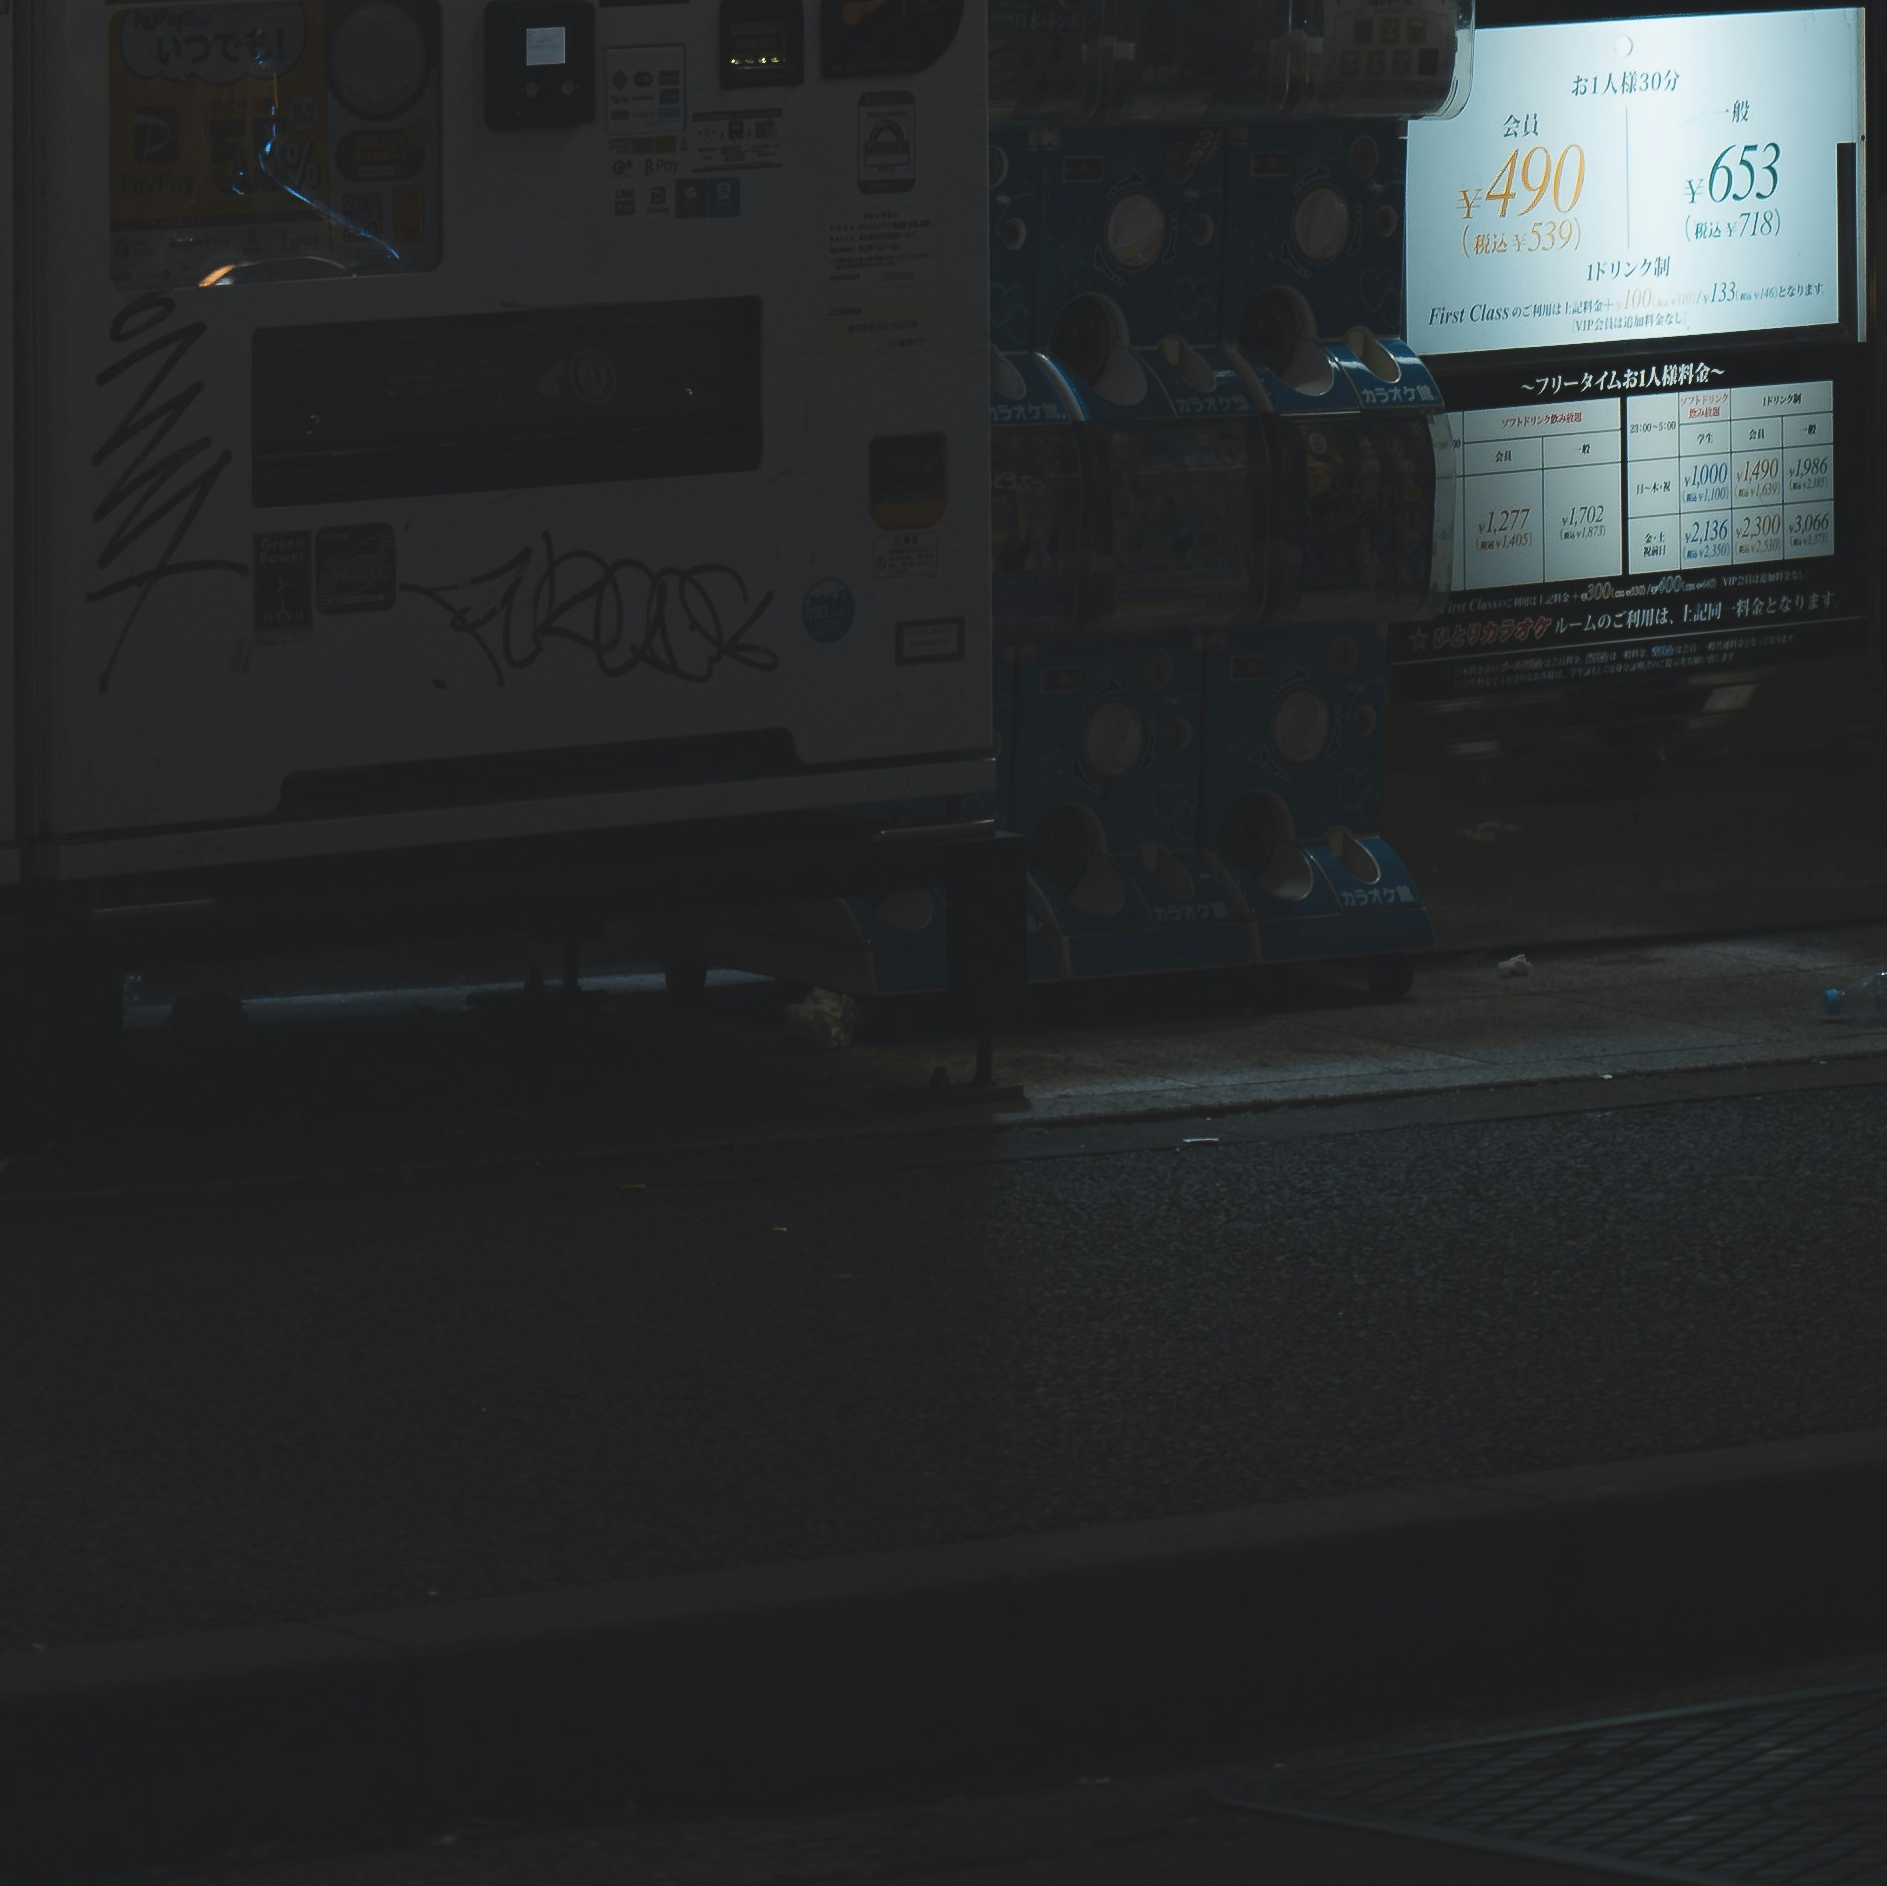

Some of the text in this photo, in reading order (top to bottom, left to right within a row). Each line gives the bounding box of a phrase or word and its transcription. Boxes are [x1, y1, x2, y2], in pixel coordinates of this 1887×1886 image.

[1570, 70, 1680, 97] お1人様30分
[1503, 114, 1539, 139] 会員
[121, 172, 195, 199] PayPay
[1457, 143, 1586, 220] ¥490
[1684, 142, 1782, 204] ¥653
[1585, 255, 1671, 283] 1ドリンク制
[1428, 306, 1465, 326] First
[1361, 384, 1434, 403] カラオケ館
